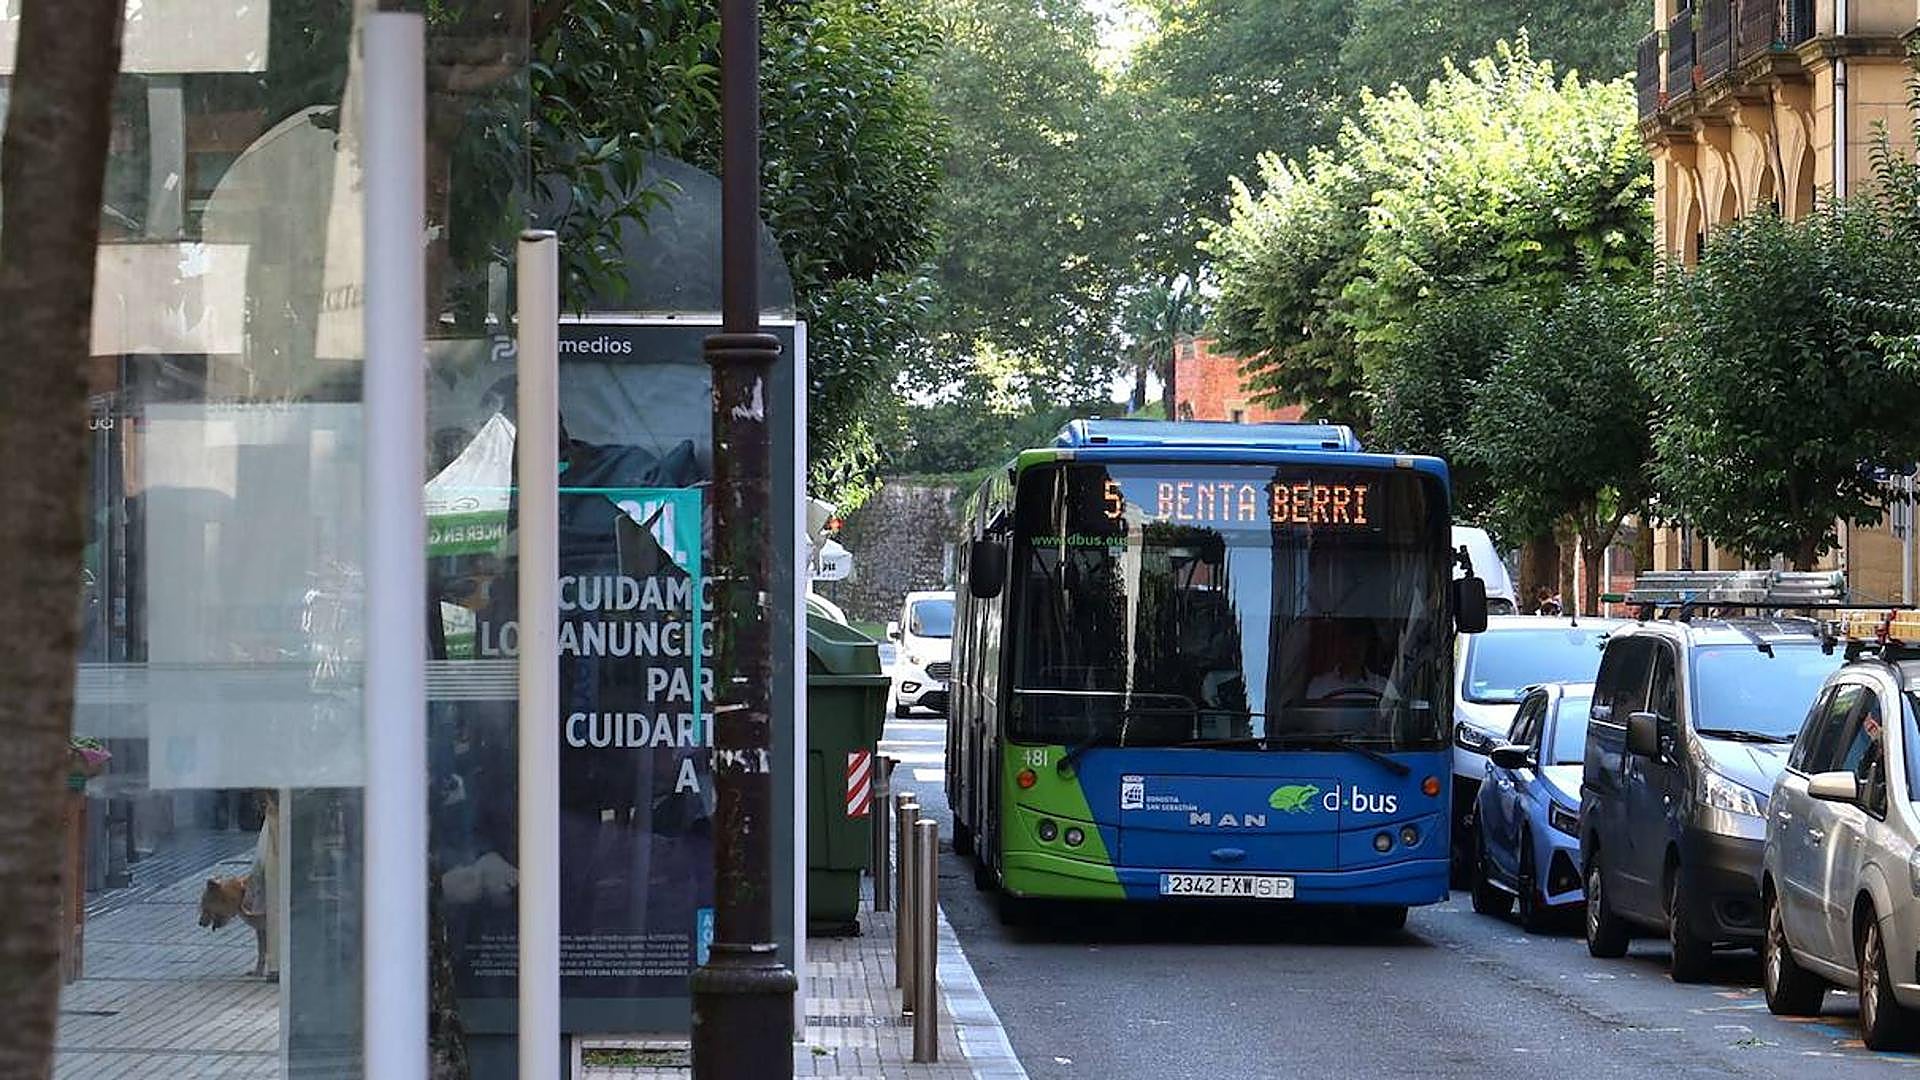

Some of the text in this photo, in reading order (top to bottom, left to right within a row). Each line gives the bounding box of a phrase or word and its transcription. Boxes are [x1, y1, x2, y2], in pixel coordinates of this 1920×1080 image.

[559, 336, 632, 353] medios
[1103, 480, 1368, 524] 5 BENTA BERRI
[674, 758, 701, 793] A
[1190, 812, 1266, 827] MAN
[1172, 877, 1290, 895] 2342 FXW SP
